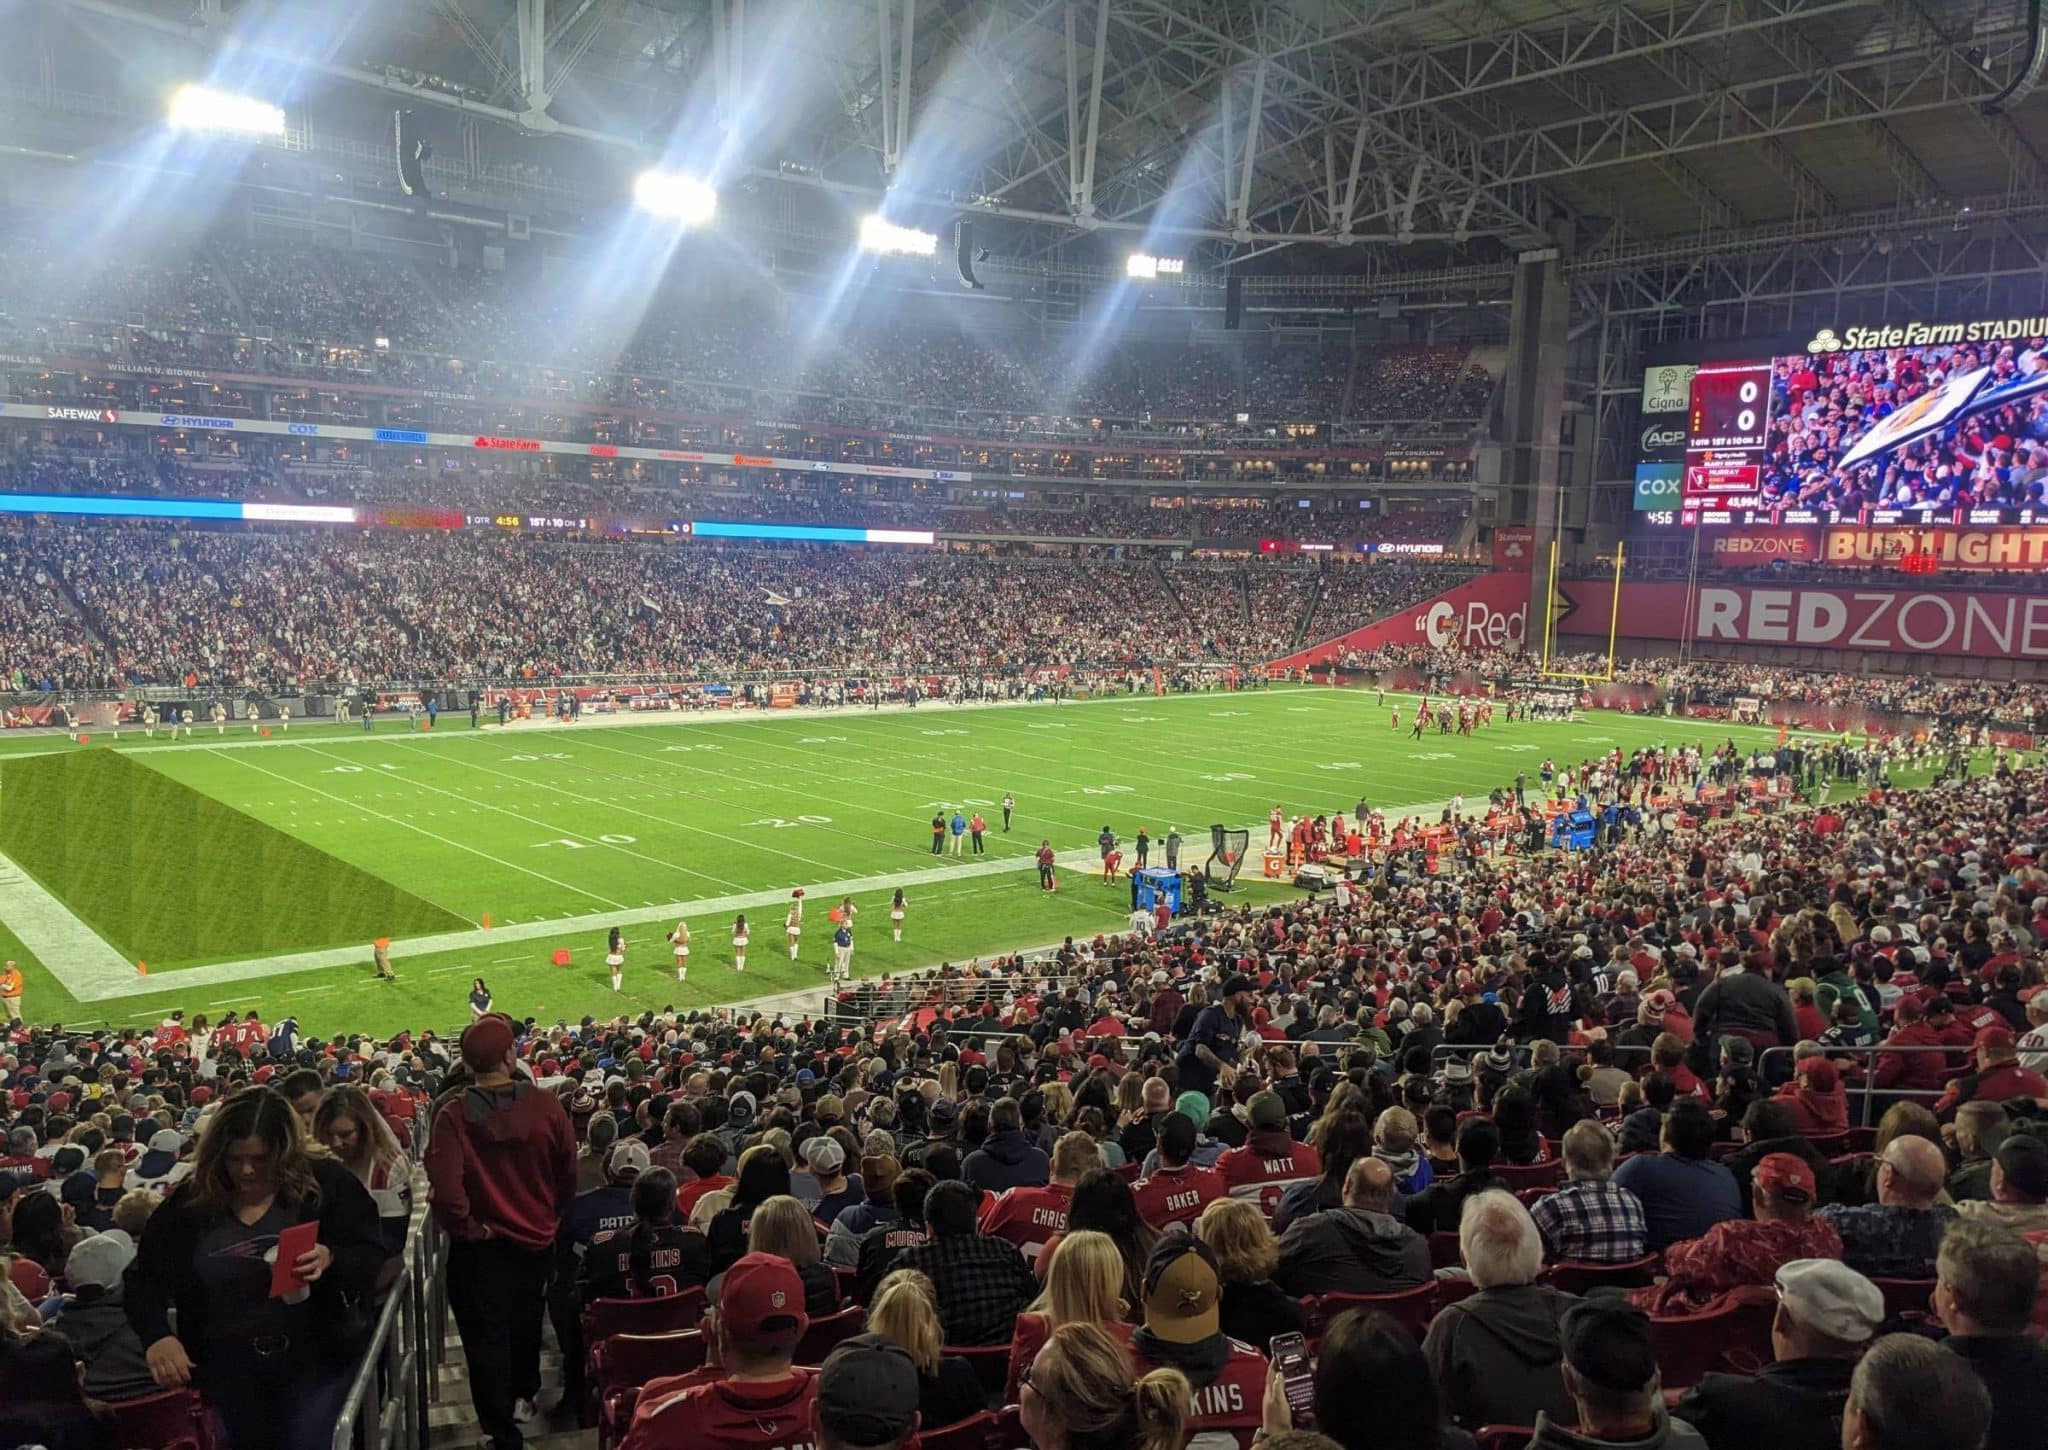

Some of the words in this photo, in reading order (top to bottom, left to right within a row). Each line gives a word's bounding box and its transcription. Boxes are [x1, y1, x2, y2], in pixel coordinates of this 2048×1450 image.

[1842, 324, 1902, 350] State
[1903, 321, 1964, 346] Farm
[1967, 317, 2048, 342] STADIU
[108, 363, 151, 374] WILLIAM
[167, 368, 208, 378] BIDWILL
[1740, 381, 1757, 403] 0
[1648, 397, 1684, 410] Cigna
[48, 407, 101, 421] SAFEWAY
[1737, 409, 1755, 431] 0
[181, 417, 234, 429] HYUNDAI
[288, 423, 318, 434] COX
[1639, 479, 1681, 495] COX
[474, 517, 490, 525] QTR
[496, 516, 519, 526] 4:56
[529, 517, 546, 527] 1ST
[552, 518, 564, 528] 10
[579, 518, 586, 529] 3
[1648, 511, 1673, 525] 4:56
[1396, 544, 1443, 553] HYUNDAI
[1714, 537, 1805, 553] REDZONE
[1828, 531, 1914, 561] BUD
[1463, 602, 1527, 647] Red
[1697, 588, 2048, 655] REDZONE
[758, 814, 833, 829] 20
[545, 834, 638, 850] 10
[1269, 860, 1280, 870] G
[1135, 917, 1146, 931] 10
[1593, 973, 1609, 993] 10
[213, 1033, 221, 1047] 3
[236, 1028, 247, 1043] 10
[1263, 1157, 1294, 1175] WATT
[1166, 1190, 1200, 1212] BAKER
[1032, 1208, 1066, 1230] CHRIS
[1190, 1383, 1244, 1416] KINS
